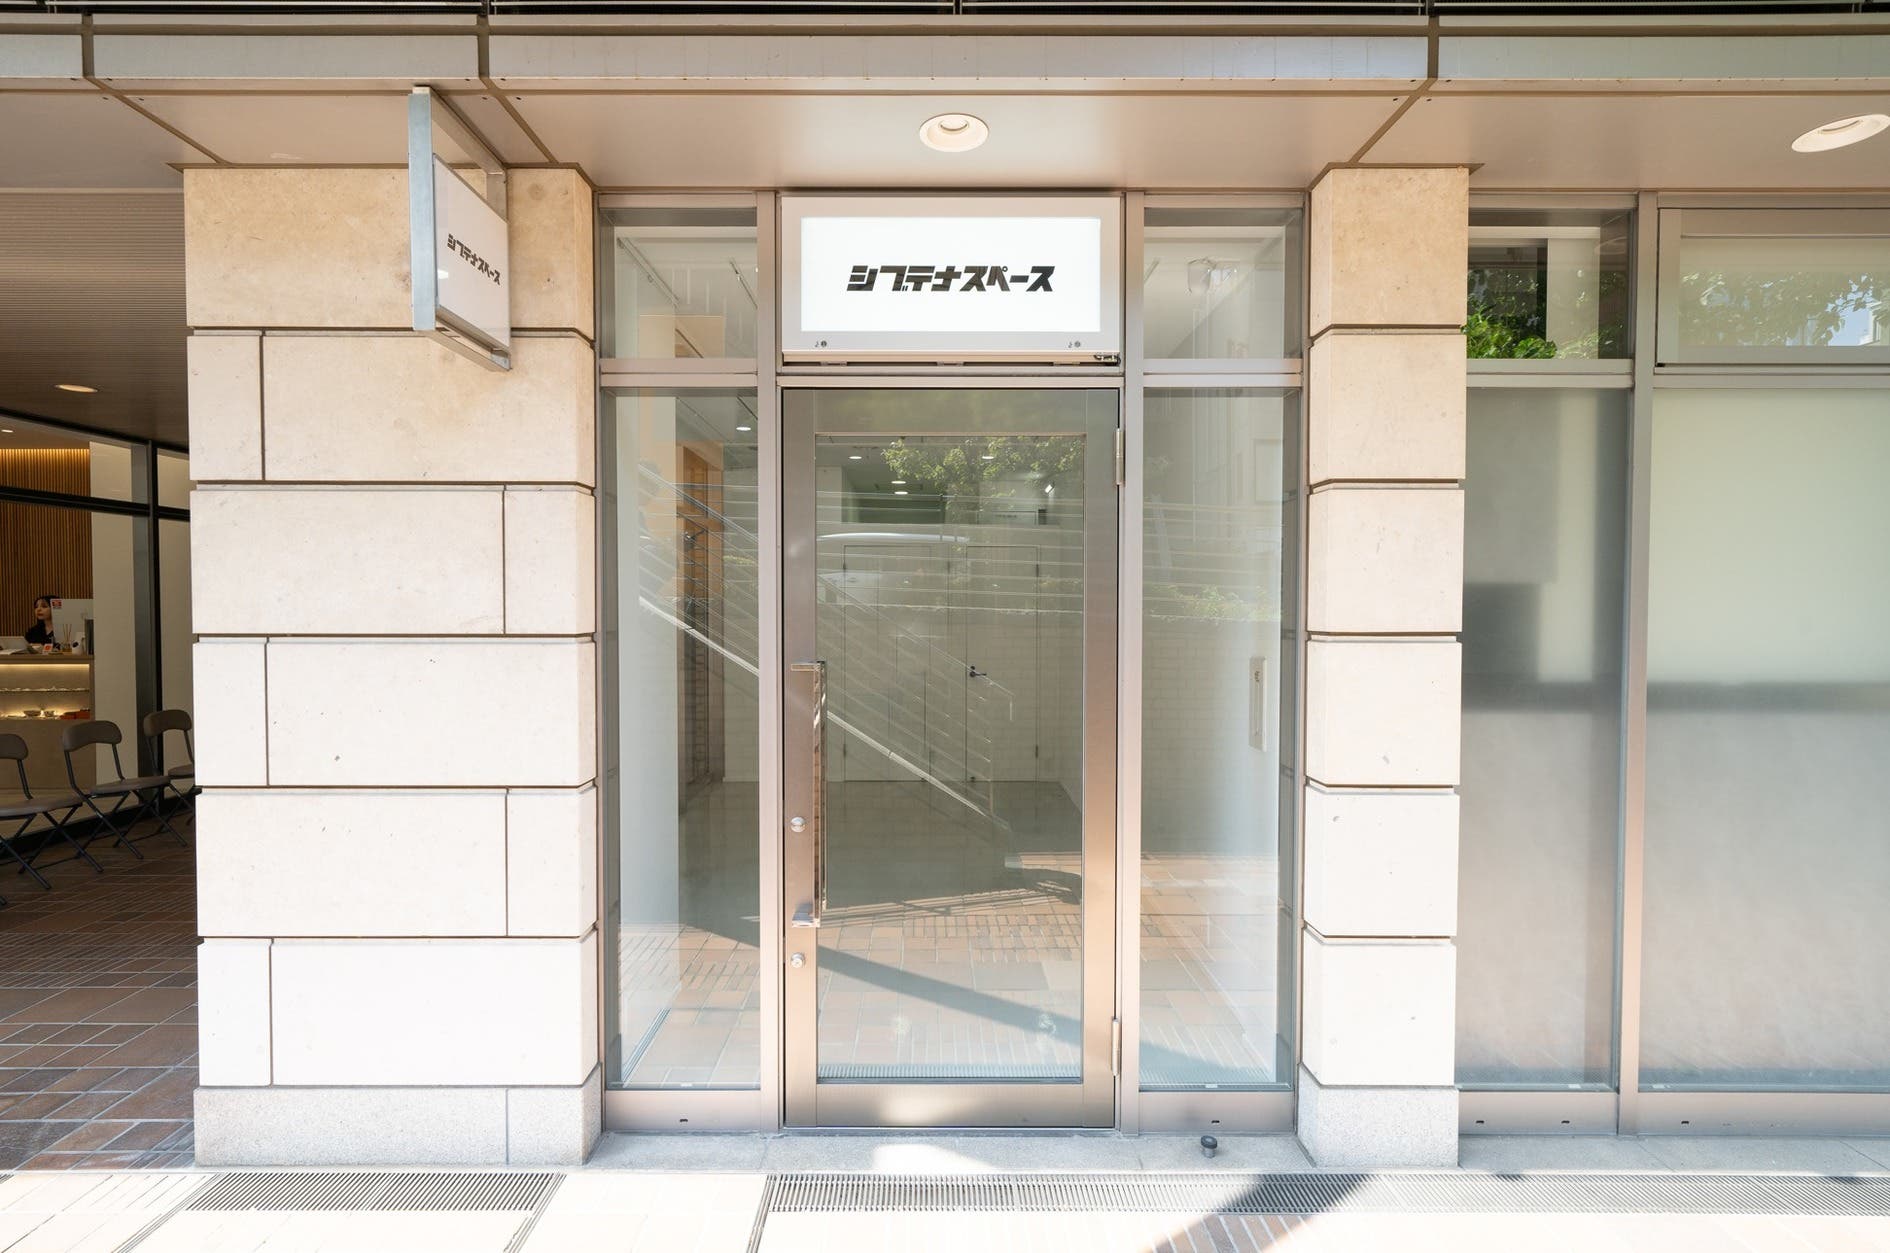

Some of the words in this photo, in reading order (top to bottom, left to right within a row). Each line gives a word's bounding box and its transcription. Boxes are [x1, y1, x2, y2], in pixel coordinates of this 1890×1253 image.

[447, 233, 501, 286] シブテナスペース
[846, 265, 1056, 292] シブテナスペース
